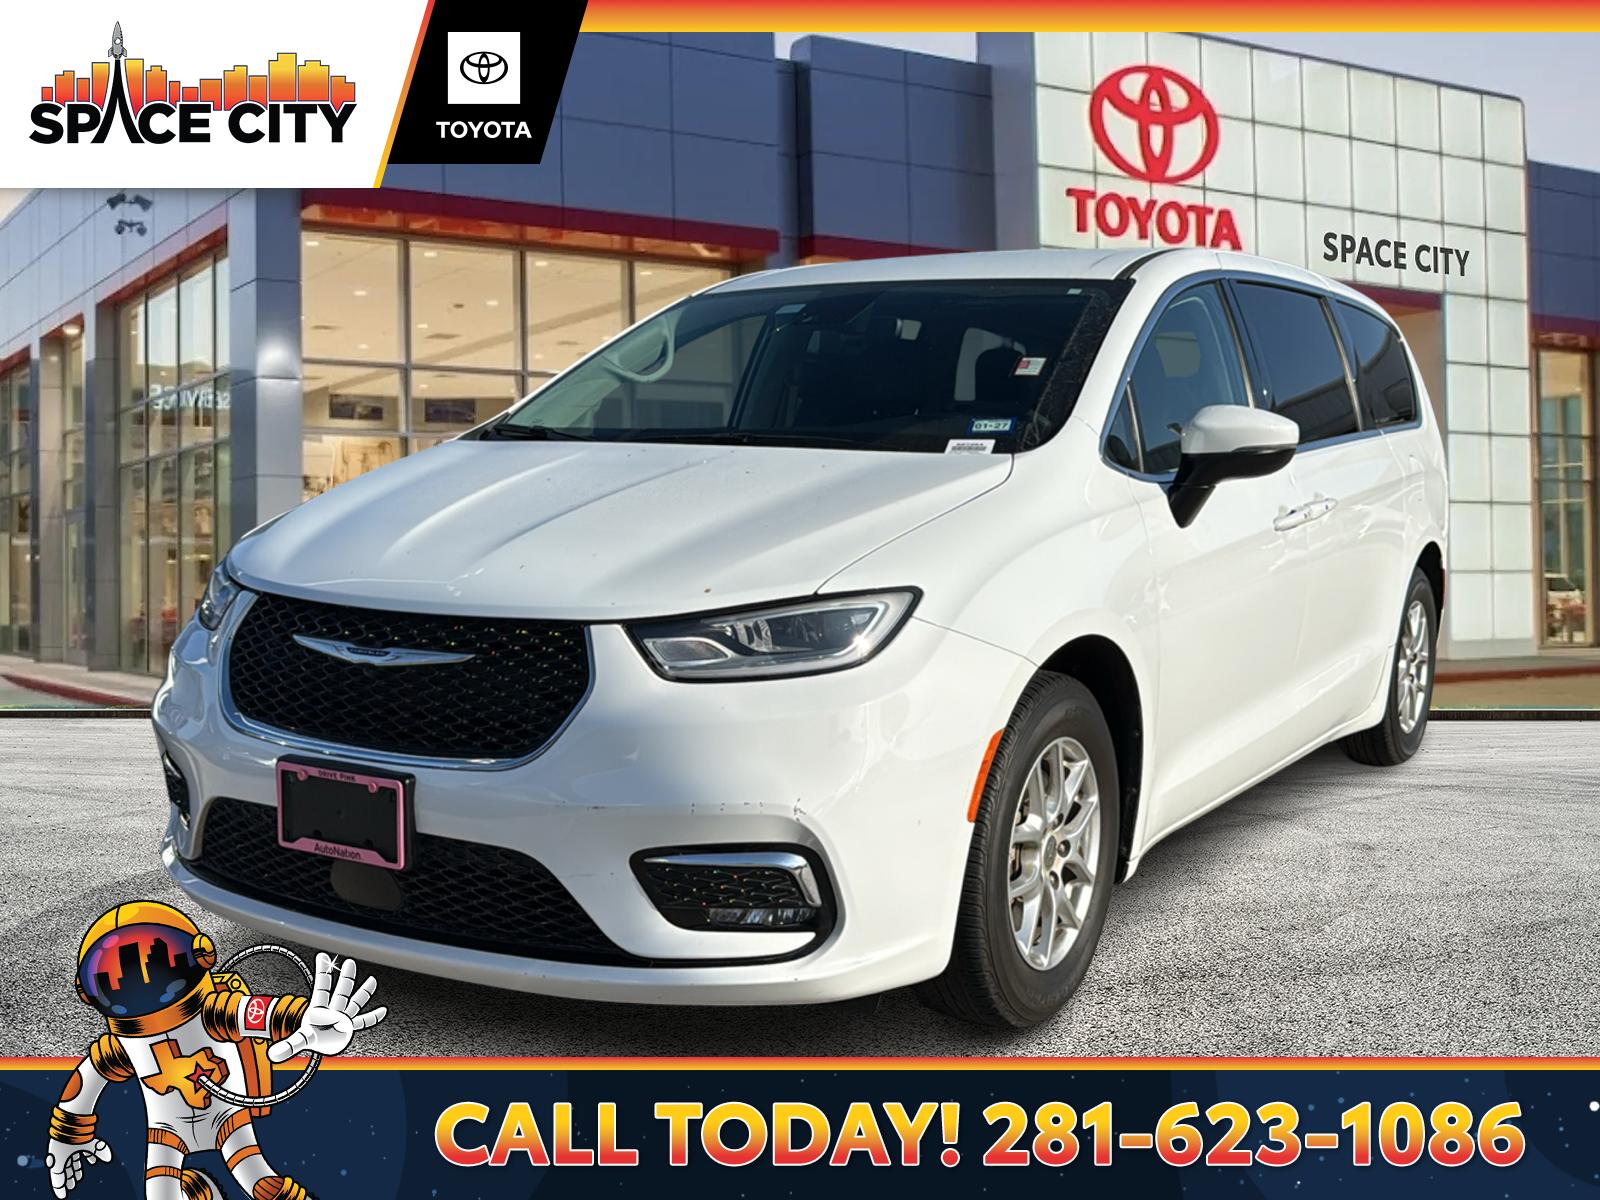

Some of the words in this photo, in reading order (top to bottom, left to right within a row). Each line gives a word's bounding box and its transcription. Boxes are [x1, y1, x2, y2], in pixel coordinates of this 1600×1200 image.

[1066, 187, 1242, 250] TOYOTA
[1323, 232, 1407, 270] SPACE
[1414, 244, 1470, 277] CITY
[314, 843, 361, 861] AutoNation
